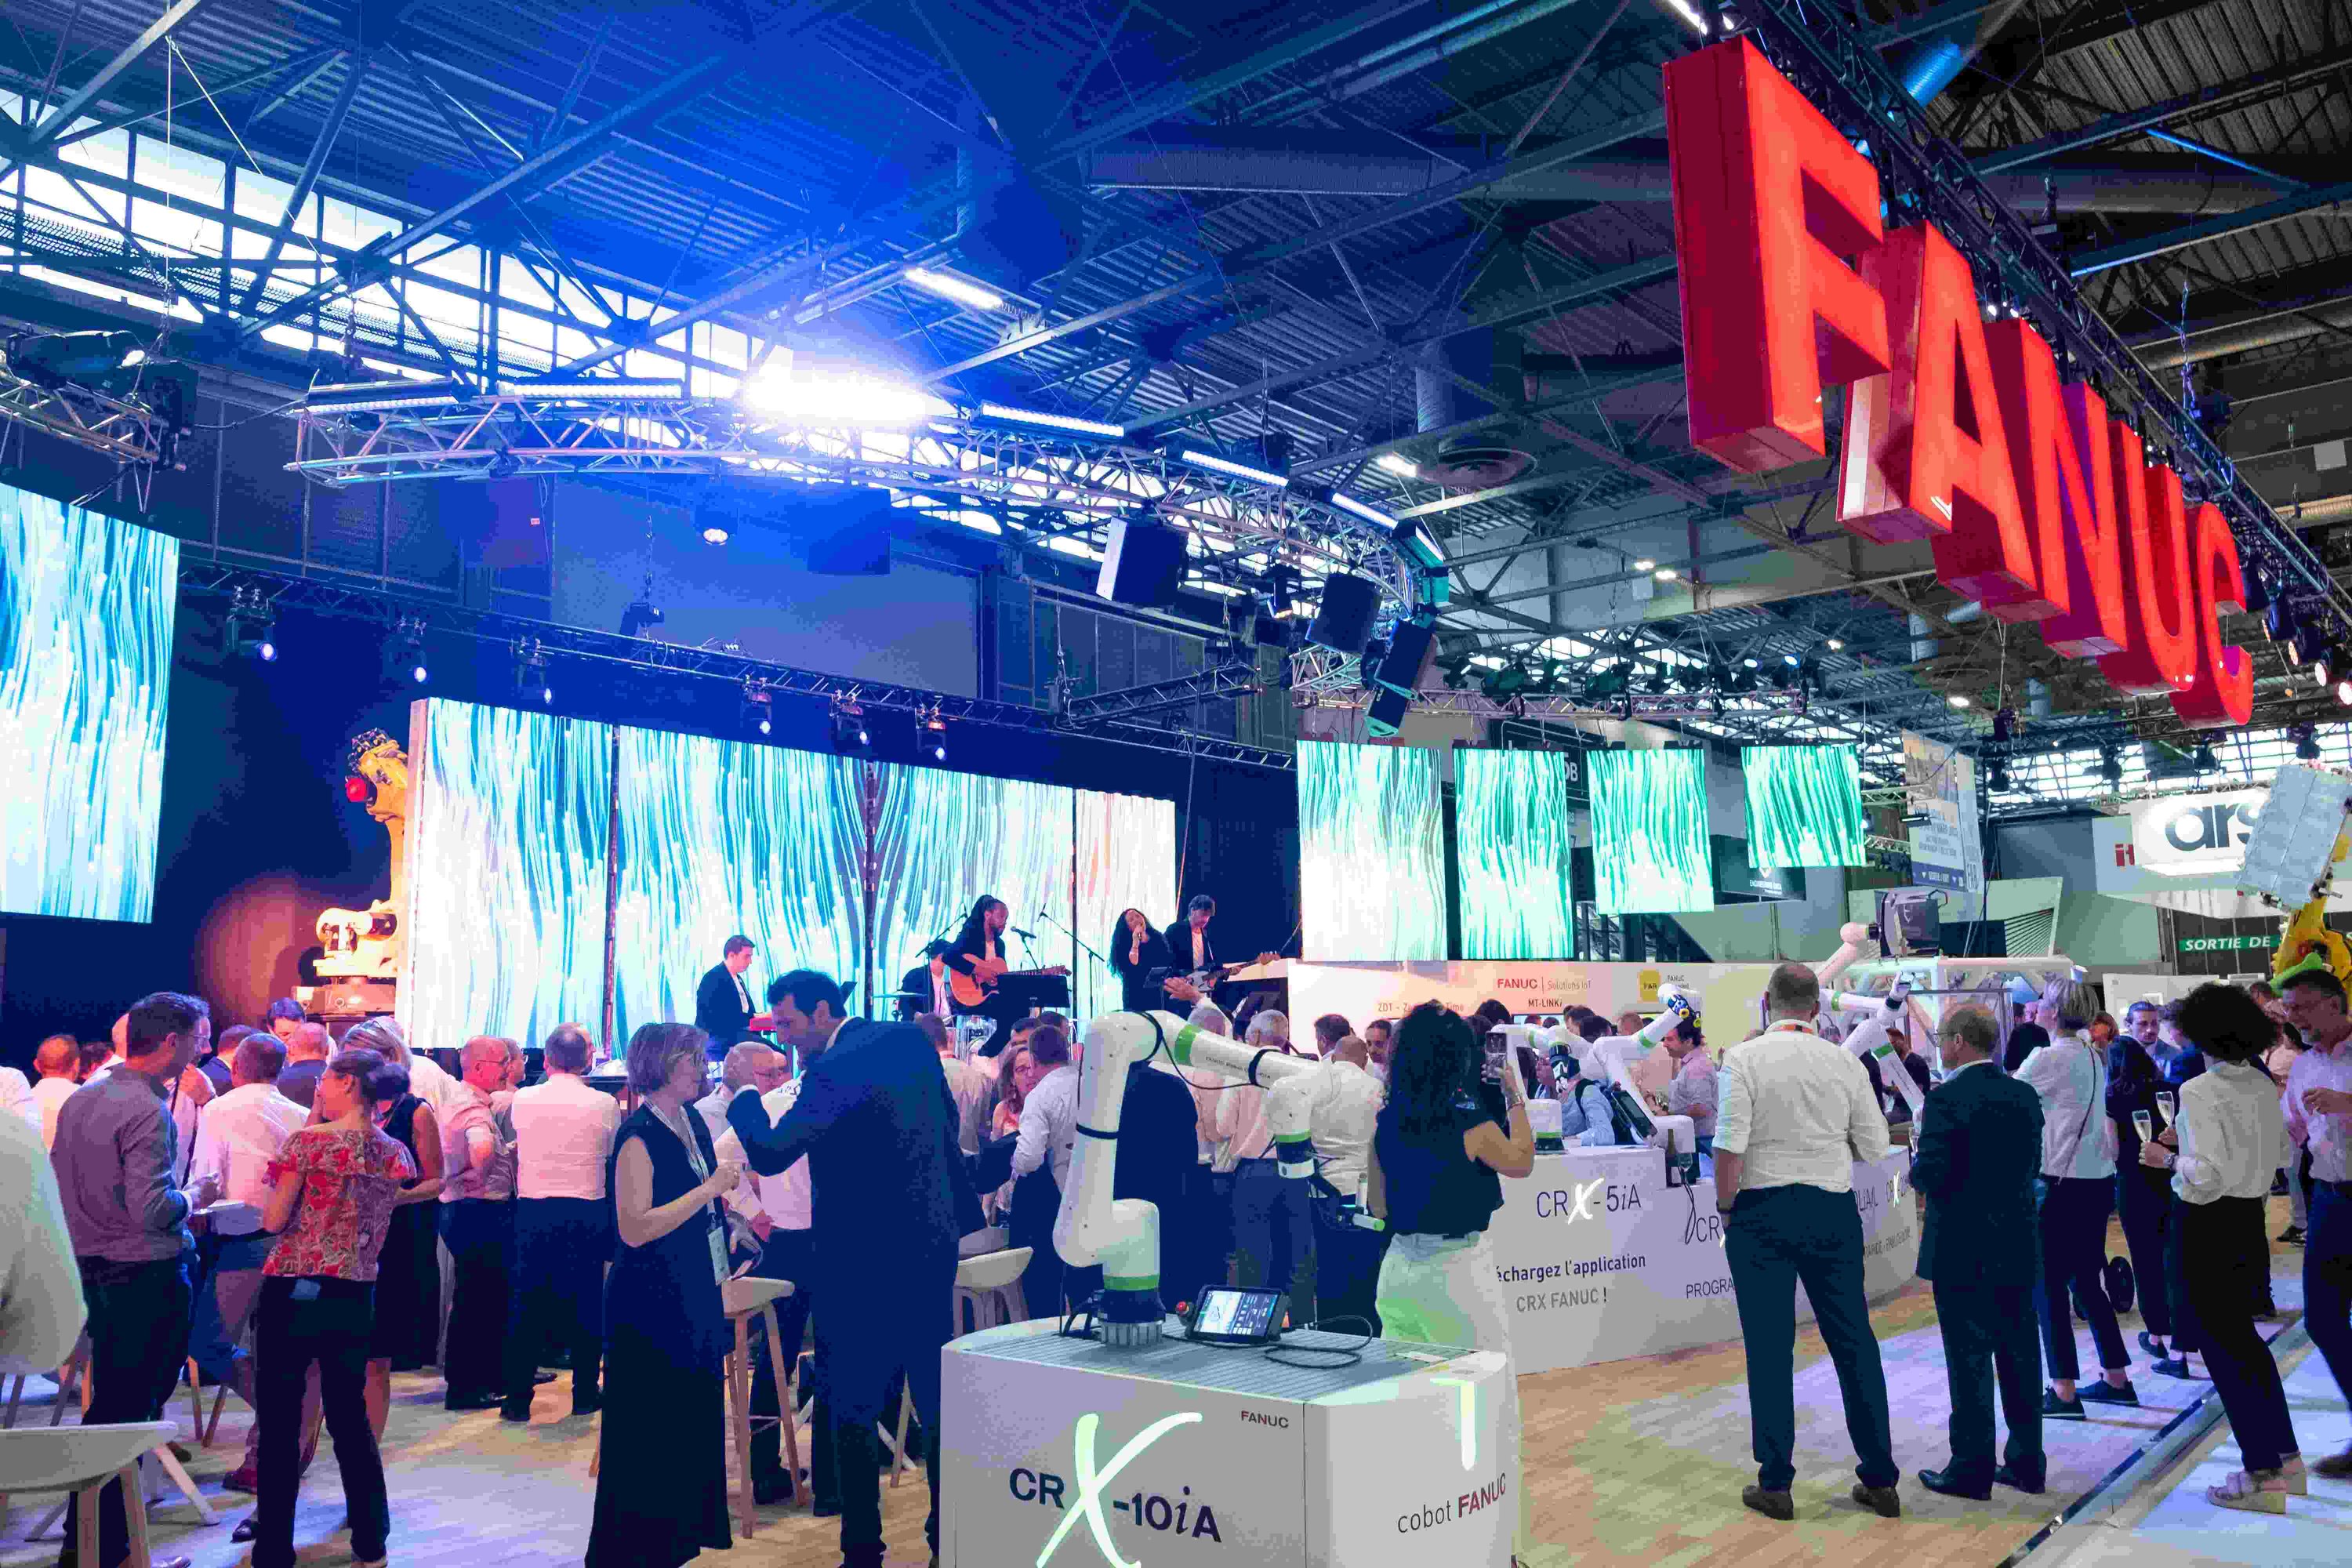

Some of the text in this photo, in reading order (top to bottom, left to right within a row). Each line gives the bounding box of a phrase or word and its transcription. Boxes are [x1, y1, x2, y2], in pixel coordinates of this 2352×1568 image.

[1663, 34, 2253, 726] FANUC
[2185, 935, 2271, 951] SORTIE DE
[1497, 978, 1537, 989] FANUC
[1547, 980, 1581, 991] Solutions
[1696, 1215, 1726, 1247] CR
[1686, 1277, 1734, 1299] PROGRA
[1516, 1294, 1546, 1313] CRX
[1551, 1288, 1599, 1308] FANUC
[1240, 1410, 1290, 1429] FANUC
[1397, 1472, 1506, 1534] cobot FANUC
